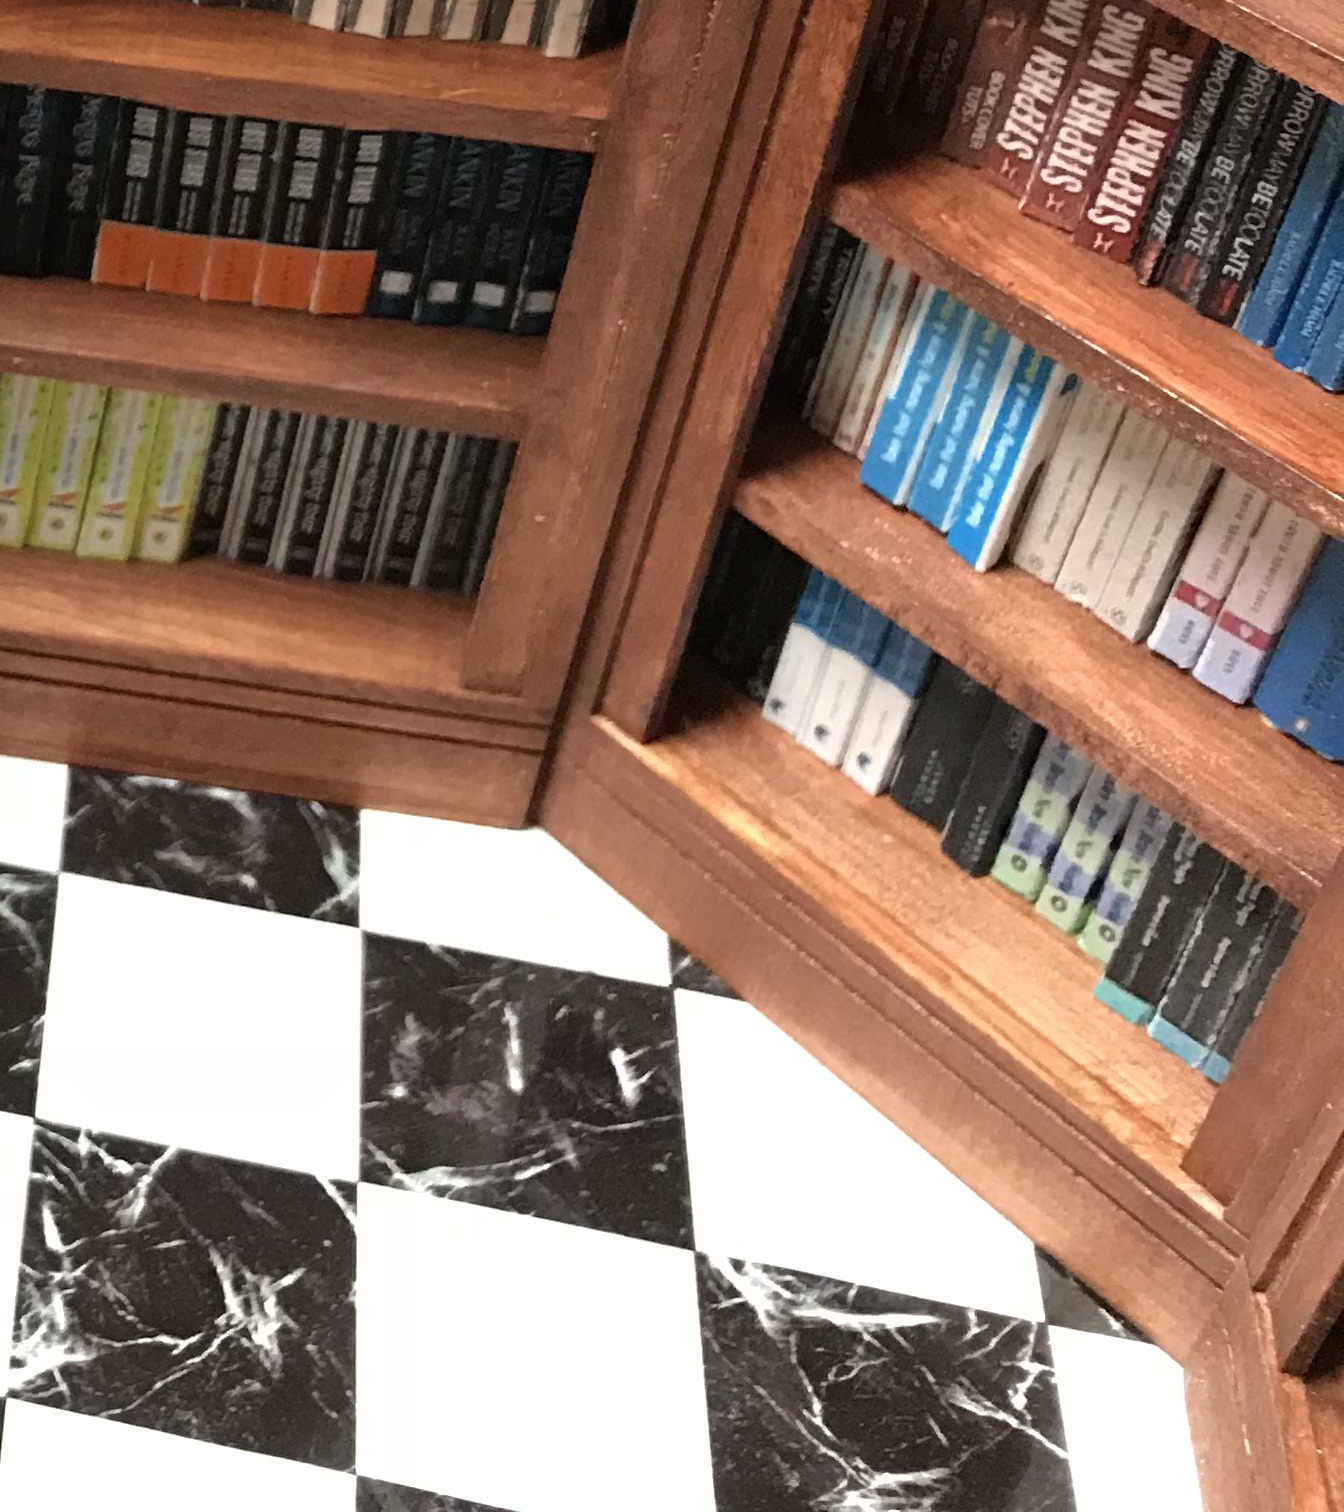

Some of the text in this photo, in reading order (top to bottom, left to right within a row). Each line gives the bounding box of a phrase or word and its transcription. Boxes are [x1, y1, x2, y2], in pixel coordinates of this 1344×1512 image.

[965, 68, 1007, 151] BOOK COVER
[997, 43, 1068, 162] STEPHEN
[1042, 1, 1146, 196] STEPHEN KING
[1088, 43, 1195, 237] STEPHEN KING
[449, 142, 483, 208] ANKIN
